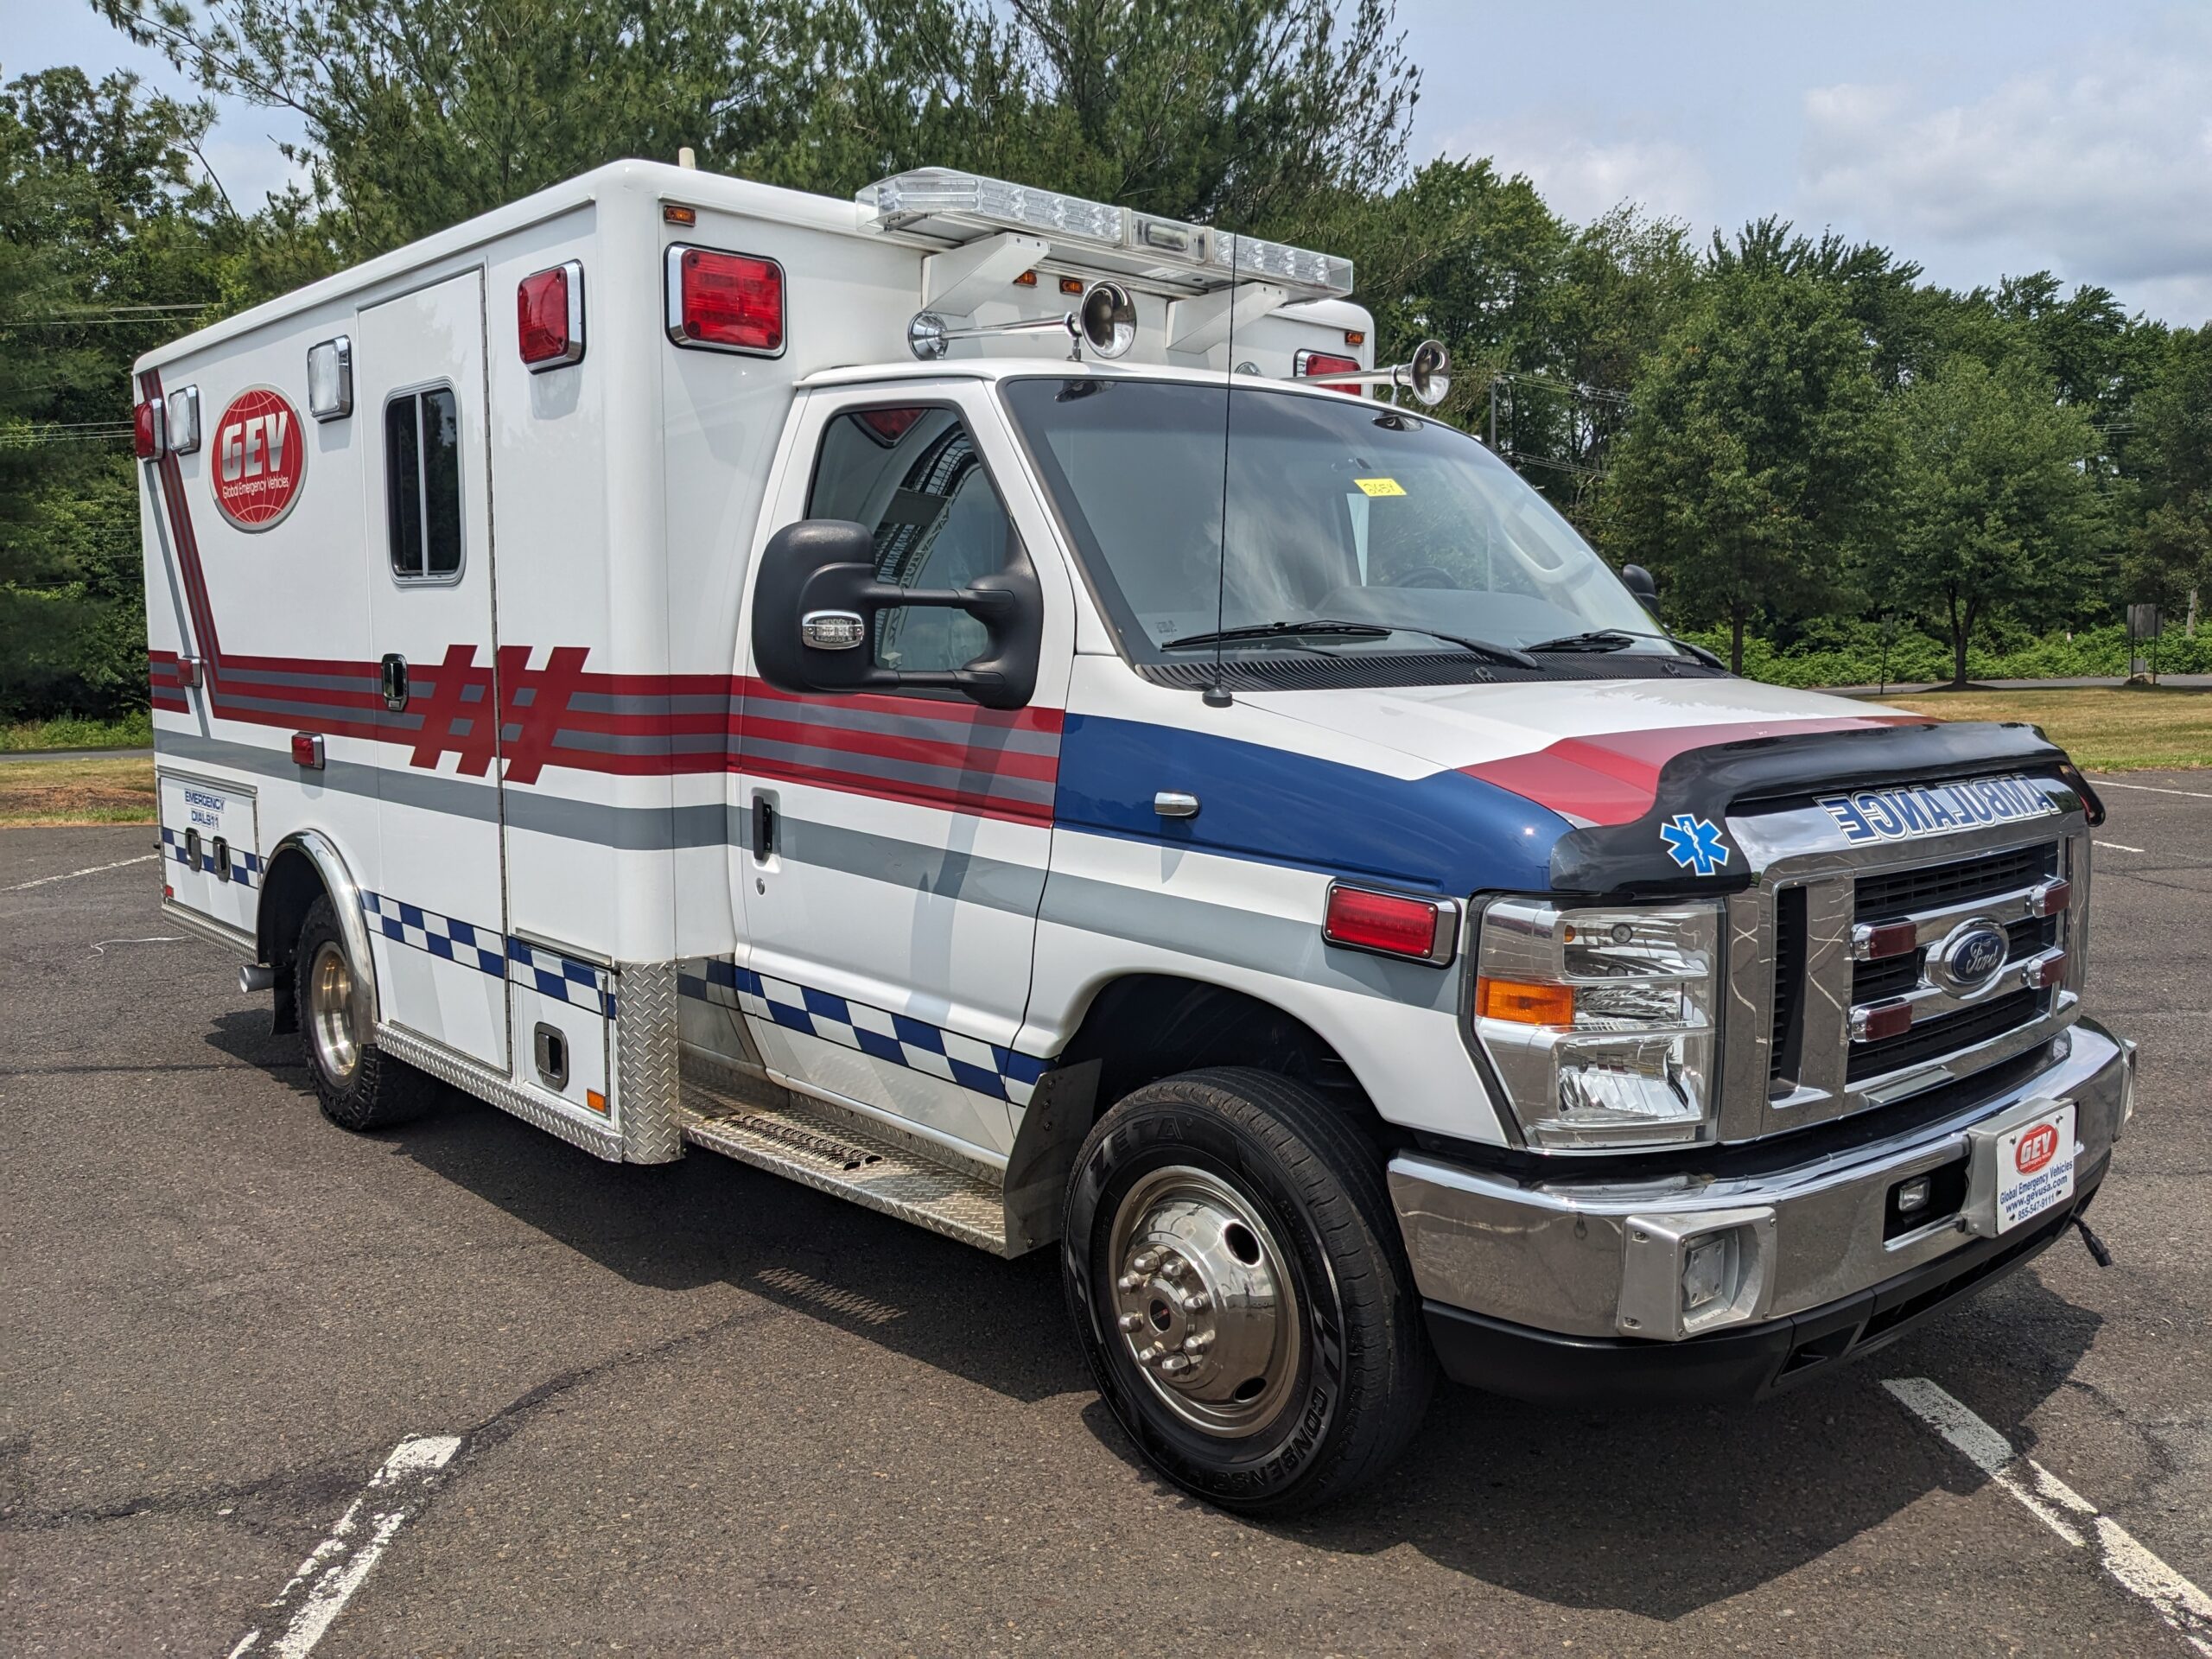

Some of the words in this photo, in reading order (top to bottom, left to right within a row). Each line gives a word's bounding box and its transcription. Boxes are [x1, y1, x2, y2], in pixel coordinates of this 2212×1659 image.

[222, 410, 288, 482] GEV
[223, 483, 239, 499] Global
[239, 481, 267, 496] Emergency
[267, 474, 289, 490] Vehicles
[185, 790, 225, 811] EMERGENCY
[1966, 940, 1999, 974] Ford
[1087, 1115, 1183, 1190] ZETA
[2020, 1130, 2052, 1164] GEV
[1999, 1185, 2018, 1205] Global
[2018, 1173, 2049, 1195] Emergency
[2050, 1160, 2073, 1179] Vehicles
[2005, 1175, 2068, 1213] www.gevusa.com
[2018, 1193, 2055, 1220] 855-547-9111
